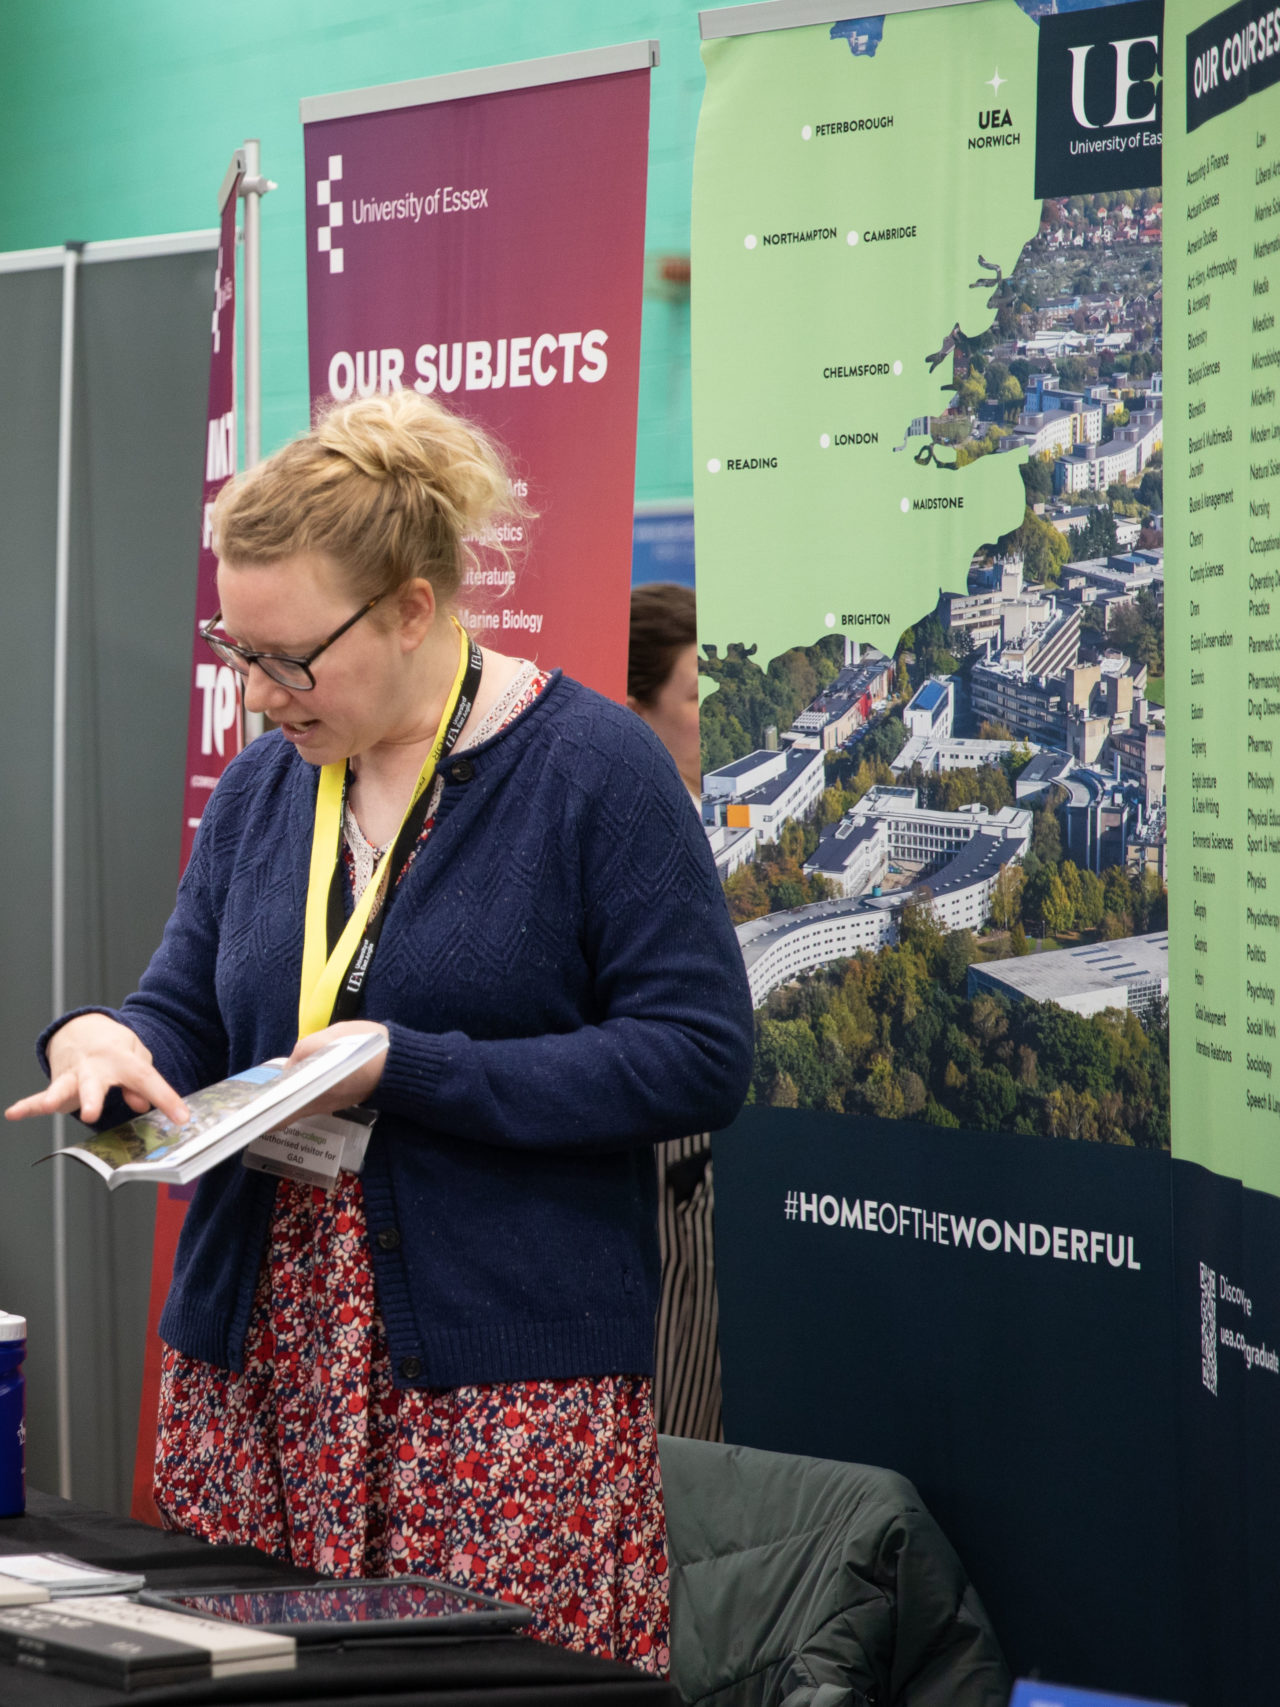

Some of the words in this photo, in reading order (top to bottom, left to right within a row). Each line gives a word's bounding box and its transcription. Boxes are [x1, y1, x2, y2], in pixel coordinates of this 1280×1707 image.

[1193, 45, 1219, 99] OUR
[1222, 7, 1280, 81] COURSES
[815, 116, 894, 137] PETERBOROUGH
[978, 109, 1012, 130] UEA
[968, 133, 1020, 151] NORWICH
[1070, 136, 1127, 155] University
[1128, 132, 1141, 148] of
[352, 191, 424, 225] University
[425, 189, 441, 215] of
[443, 186, 488, 212] Essex
[1255, 203, 1272, 223] Marine
[763, 227, 837, 247] NORTHAMPTON
[863, 225, 917, 244] CAMBRIDGE
[1253, 276, 1269, 296] Media
[1252, 312, 1275, 334] Medicine
[328, 348, 405, 401] OUR
[414, 329, 609, 395] SUBJECTS
[823, 363, 890, 379] CHELMSFORD
[1251, 386, 1275, 407] Midwifery
[834, 433, 879, 446] LONDON
[1251, 424, 1270, 444] Modern
[727, 457, 778, 471] READING
[1250, 461, 1269, 480] Natural
[913, 497, 964, 511] MAIDSTONE
[1250, 499, 1270, 519] Nursing
[1205, 561, 1224, 577] Sciences
[1249, 572, 1274, 595] Operating
[1249, 599, 1270, 617] Practice
[459, 609, 500, 629] Marine
[503, 609, 543, 633] Biology
[841, 614, 890, 626] BRIGHTON
[1249, 635, 1274, 653] Paramedic
[1248, 699, 1262, 720] Drug
[1248, 735, 1273, 757] Pharmacy
[1248, 771, 1274, 794] Philosophy
[1248, 808, 1268, 830] Physical
[1212, 832, 1233, 850] Sciences
[1248, 834, 1263, 857] Sport
[1247, 870, 1267, 894] Physics
[1247, 943, 1267, 963] Politics
[1247, 980, 1275, 1006] Psychology
[1247, 1016, 1263, 1036] Social
[1264, 1019, 1276, 1039] Work
[1247, 1052, 1272, 1079] Sociology
[1247, 1088, 1267, 1112] Speech
[287, 1153, 304, 1164] GAD
[300, 1142, 323, 1157] visitor
[324, 1150, 336, 1161] for
[784, 1190, 1141, 1270] #HOMEOFTHEWONDERFUL
